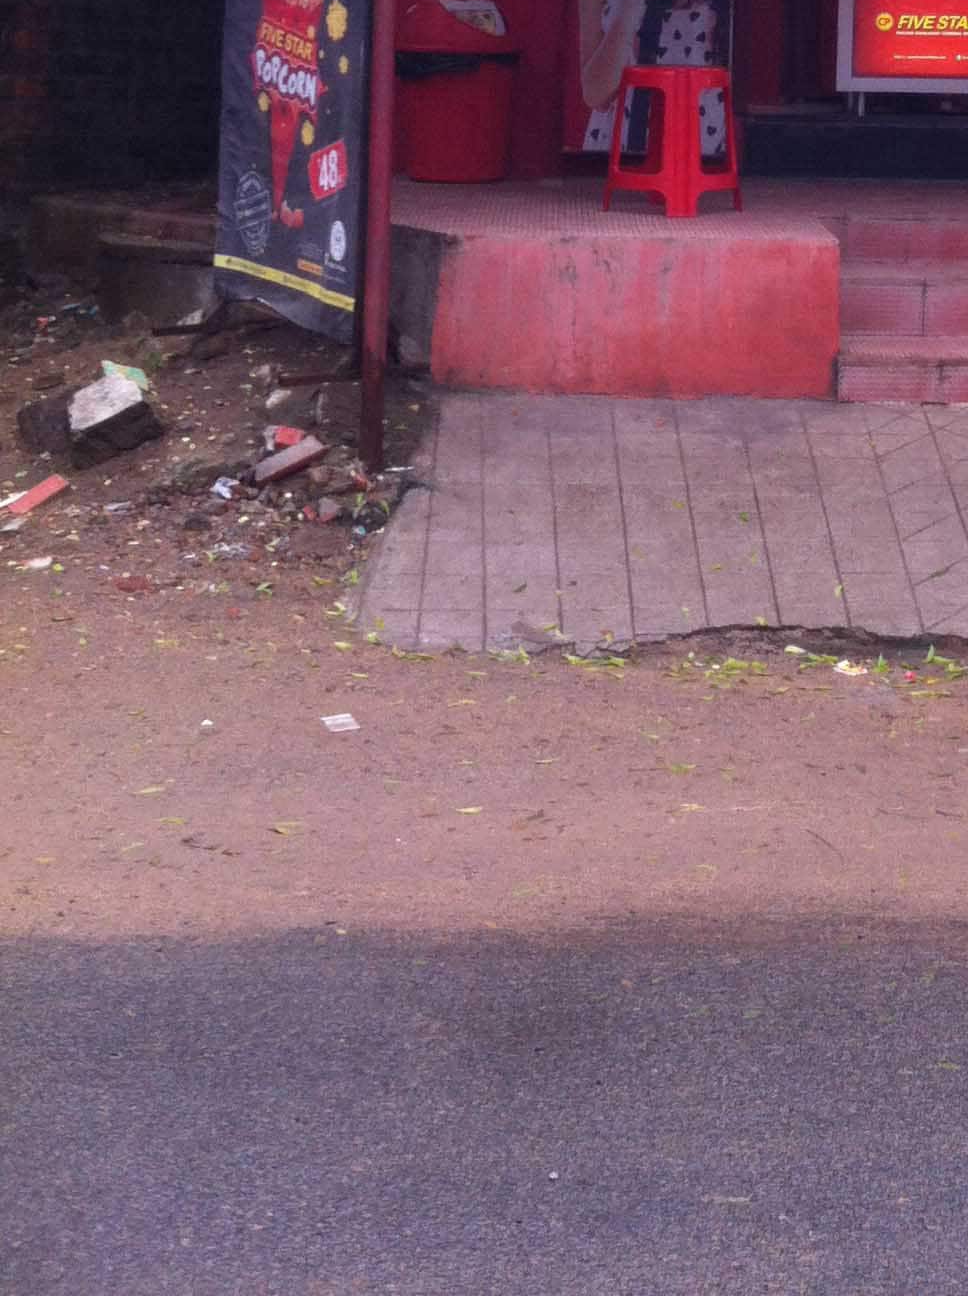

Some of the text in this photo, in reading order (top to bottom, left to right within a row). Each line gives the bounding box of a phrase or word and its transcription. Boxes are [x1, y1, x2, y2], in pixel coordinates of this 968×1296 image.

[259, 22, 314, 61] FIVE STAR
[897, 14, 937, 31] FIVE
[255, 48, 318, 106] POPCORN
